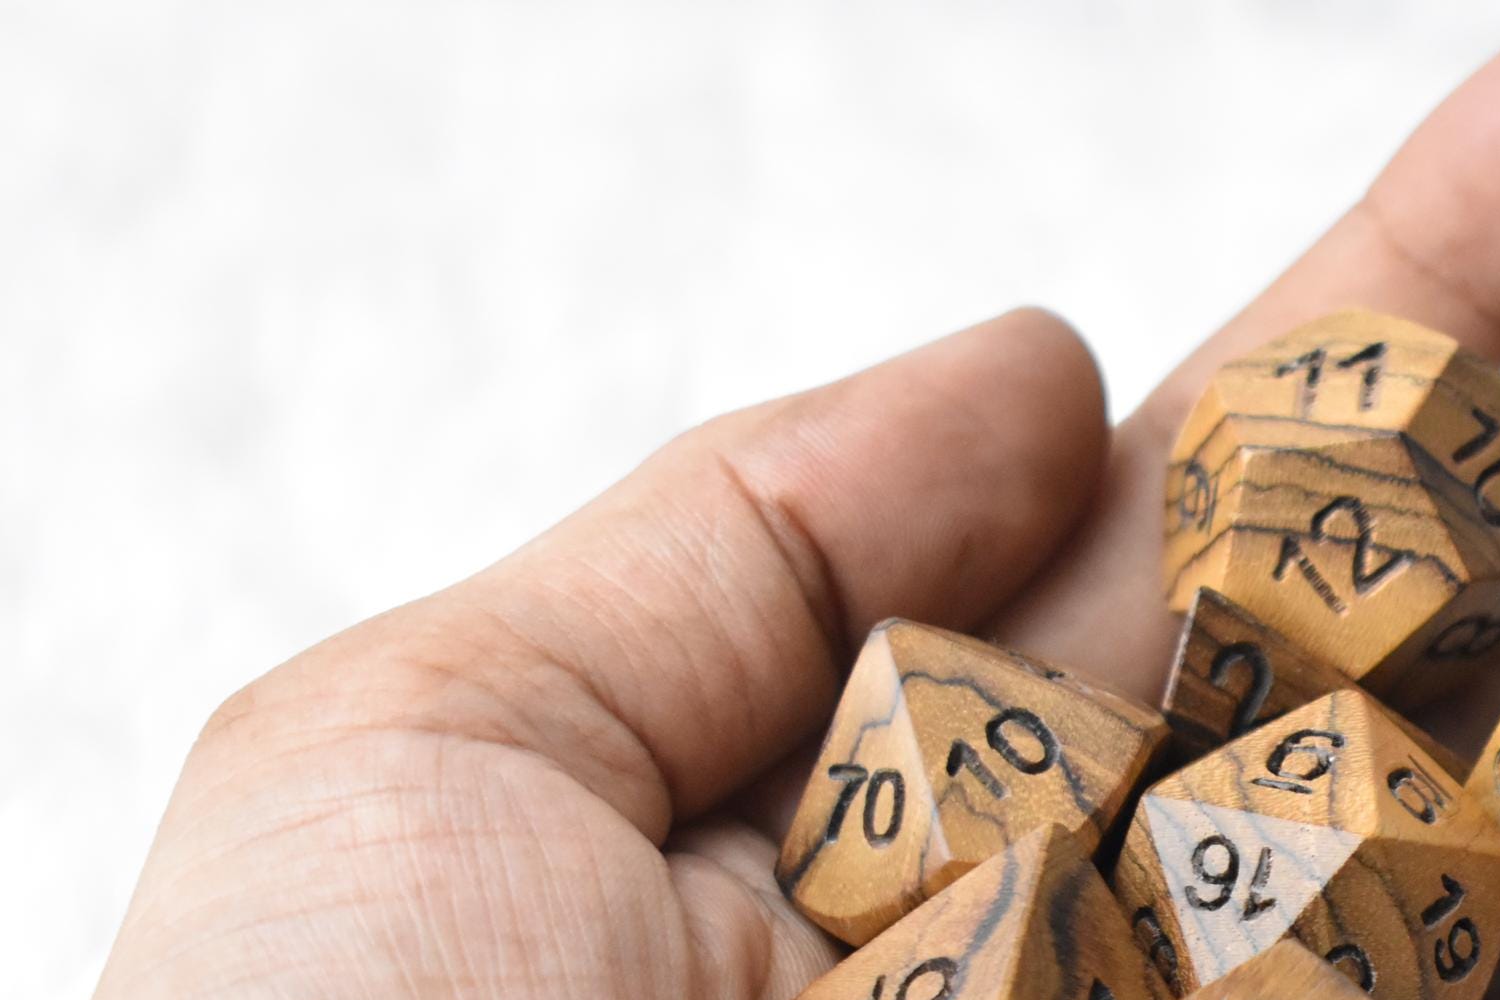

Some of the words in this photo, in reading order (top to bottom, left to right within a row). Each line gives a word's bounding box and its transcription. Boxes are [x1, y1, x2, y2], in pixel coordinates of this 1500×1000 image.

[1276, 343, 1388, 418] 11
[1273, 496, 1416, 616] 12
[946, 707, 1061, 800] 10
[828, 763, 905, 848] 70
[1185, 834, 1277, 921] 16
[1421, 873, 1481, 985] 19
